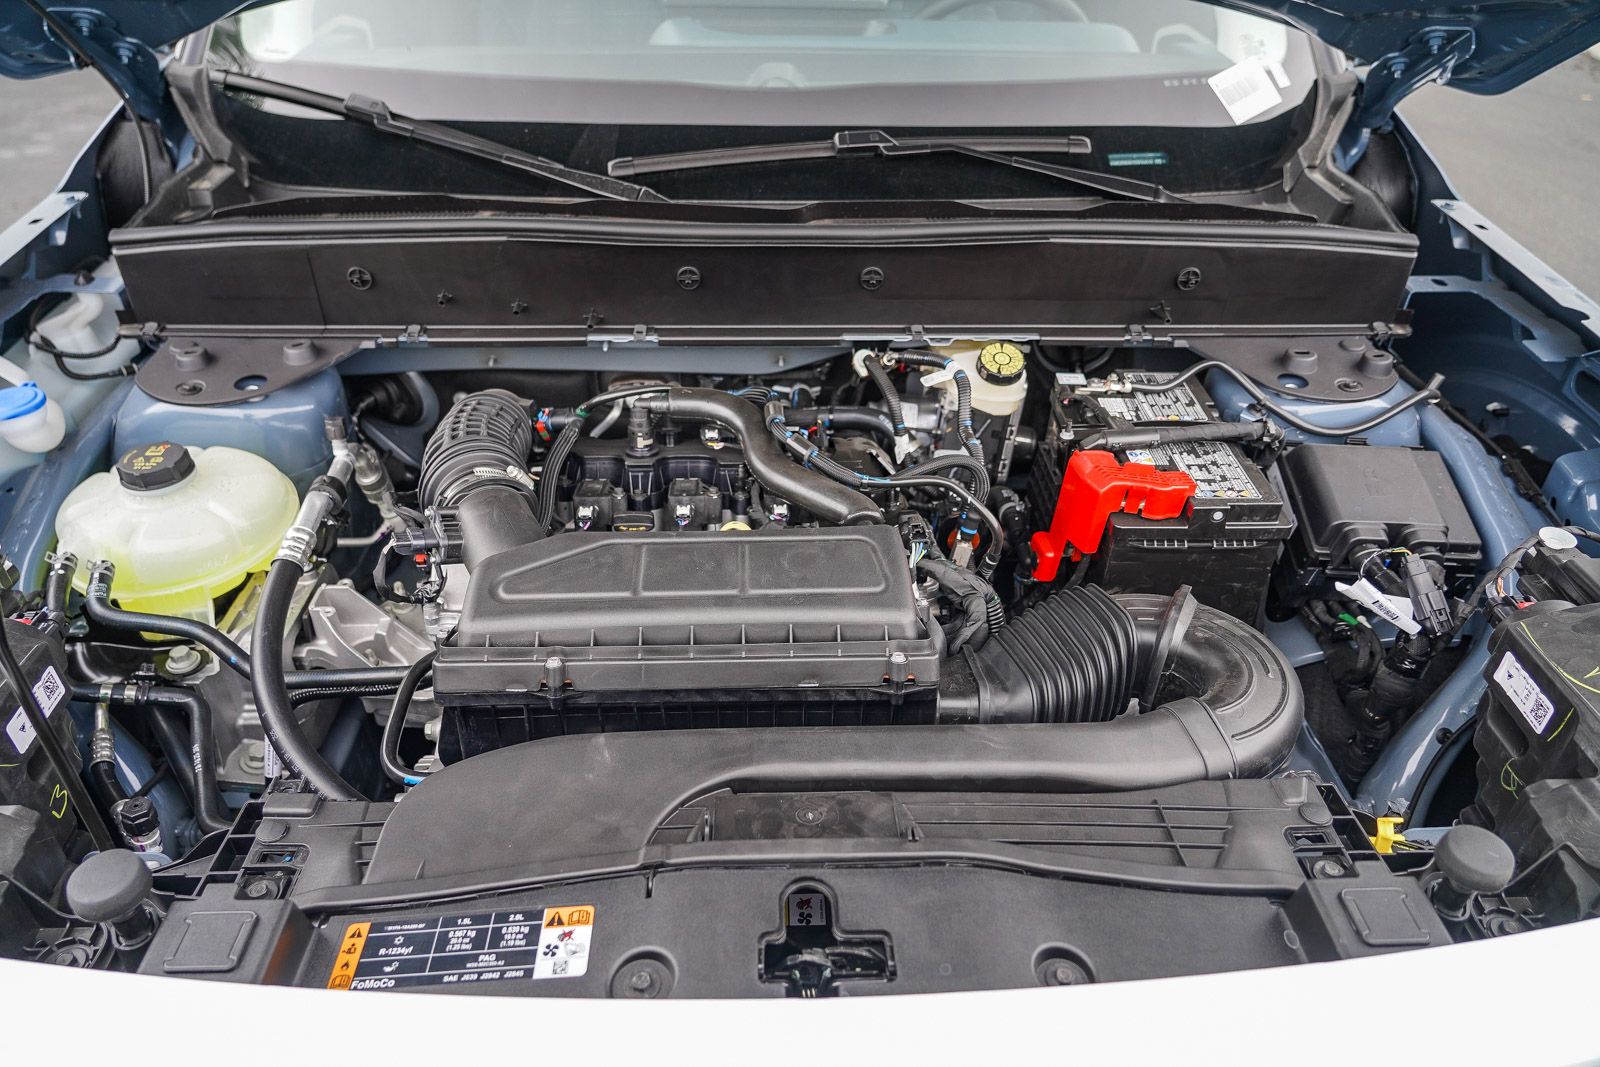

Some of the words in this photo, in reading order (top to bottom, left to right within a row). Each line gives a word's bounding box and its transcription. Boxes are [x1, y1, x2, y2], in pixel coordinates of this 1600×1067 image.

[508, 913, 525, 922] 2.0L
[448, 930, 467, 938] 0.567
[467, 929, 477, 938] kg
[520, 925, 530, 934] kg
[378, 946, 414, 955] R-1234yf
[478, 953, 496, 962] PAG
[443, 974, 458, 982] SAE
[461, 973, 478, 981] J639
[350, 979, 395, 990] FoMoCo
